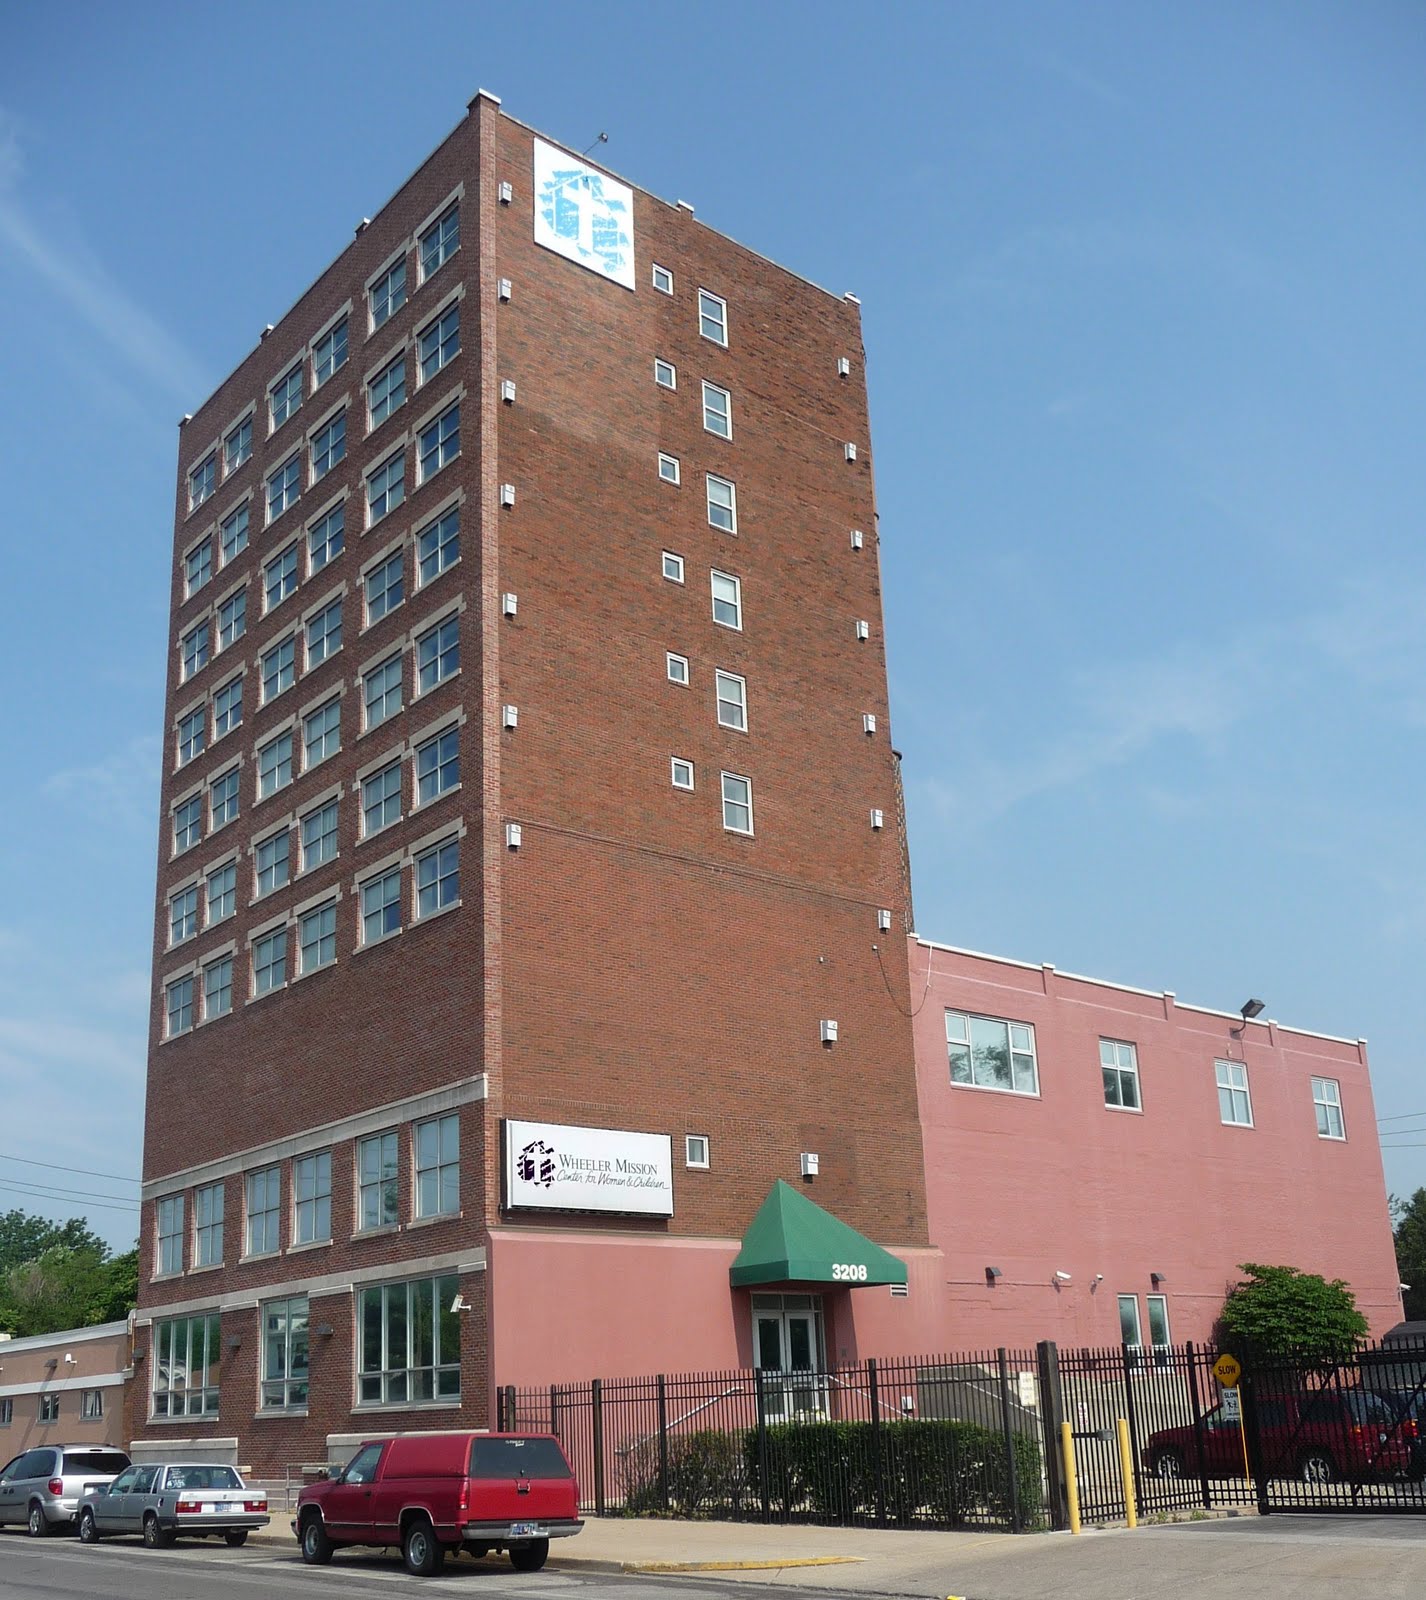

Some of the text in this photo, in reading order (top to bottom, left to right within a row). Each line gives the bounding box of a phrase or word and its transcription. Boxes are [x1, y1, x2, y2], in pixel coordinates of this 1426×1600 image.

[559, 1154, 658, 1175] WHEELER MISSION
[556, 1169, 583, 1183] Center
[585, 1169, 596, 1183] for
[598, 1172, 626, 1186] Women
[832, 1263, 868, 1280] 3208
[1218, 1366, 1236, 1375] SLOW
